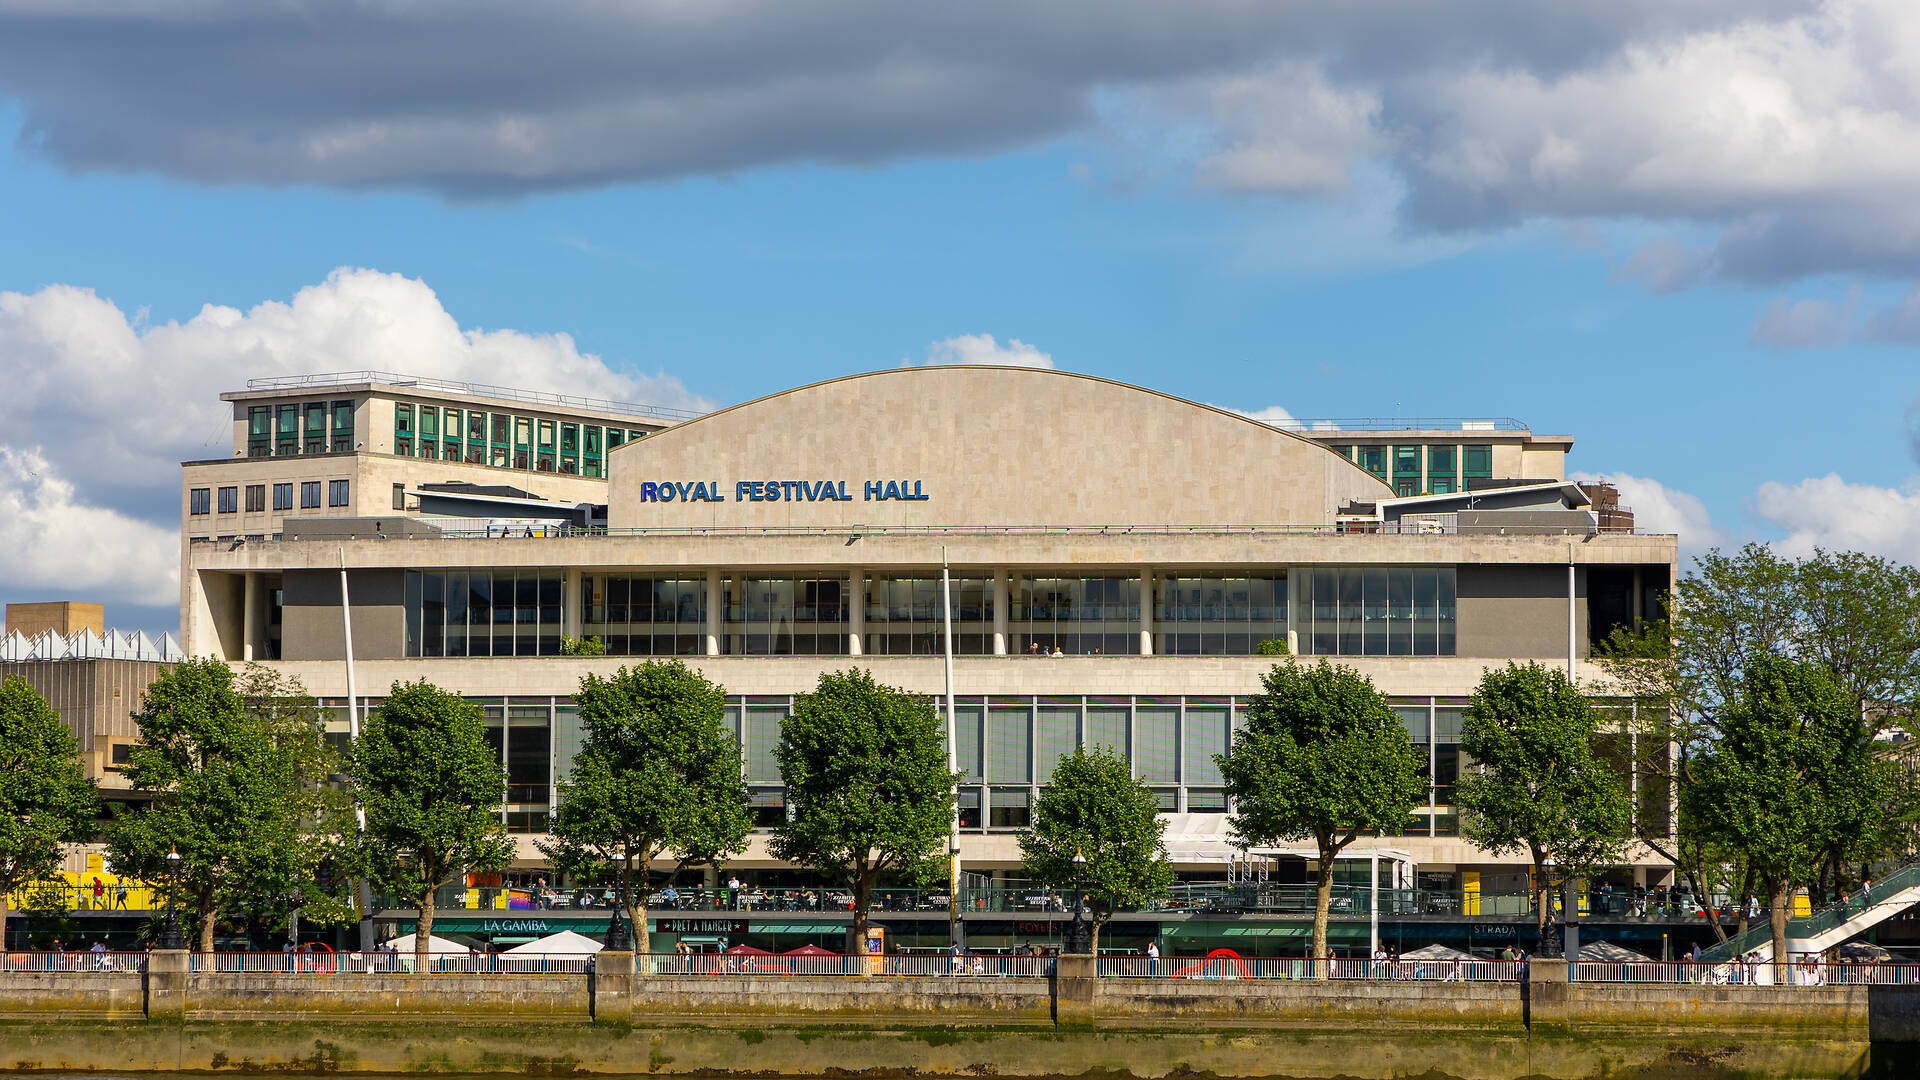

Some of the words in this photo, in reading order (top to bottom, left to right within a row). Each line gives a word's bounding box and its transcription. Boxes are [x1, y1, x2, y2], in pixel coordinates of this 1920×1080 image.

[641, 481, 724, 502] ROYAL
[736, 480, 852, 501] FESTIVAL
[864, 480, 929, 501] HALL
[484, 920, 499, 931] LA
[502, 920, 547, 931] GAMBA
[672, 920, 690, 932] PRET
[693, 921, 699, 931] A
[701, 920, 732, 932] MANGER
[1018, 922, 1058, 933] FOYLES
[1474, 925, 1516, 936] STRADA
